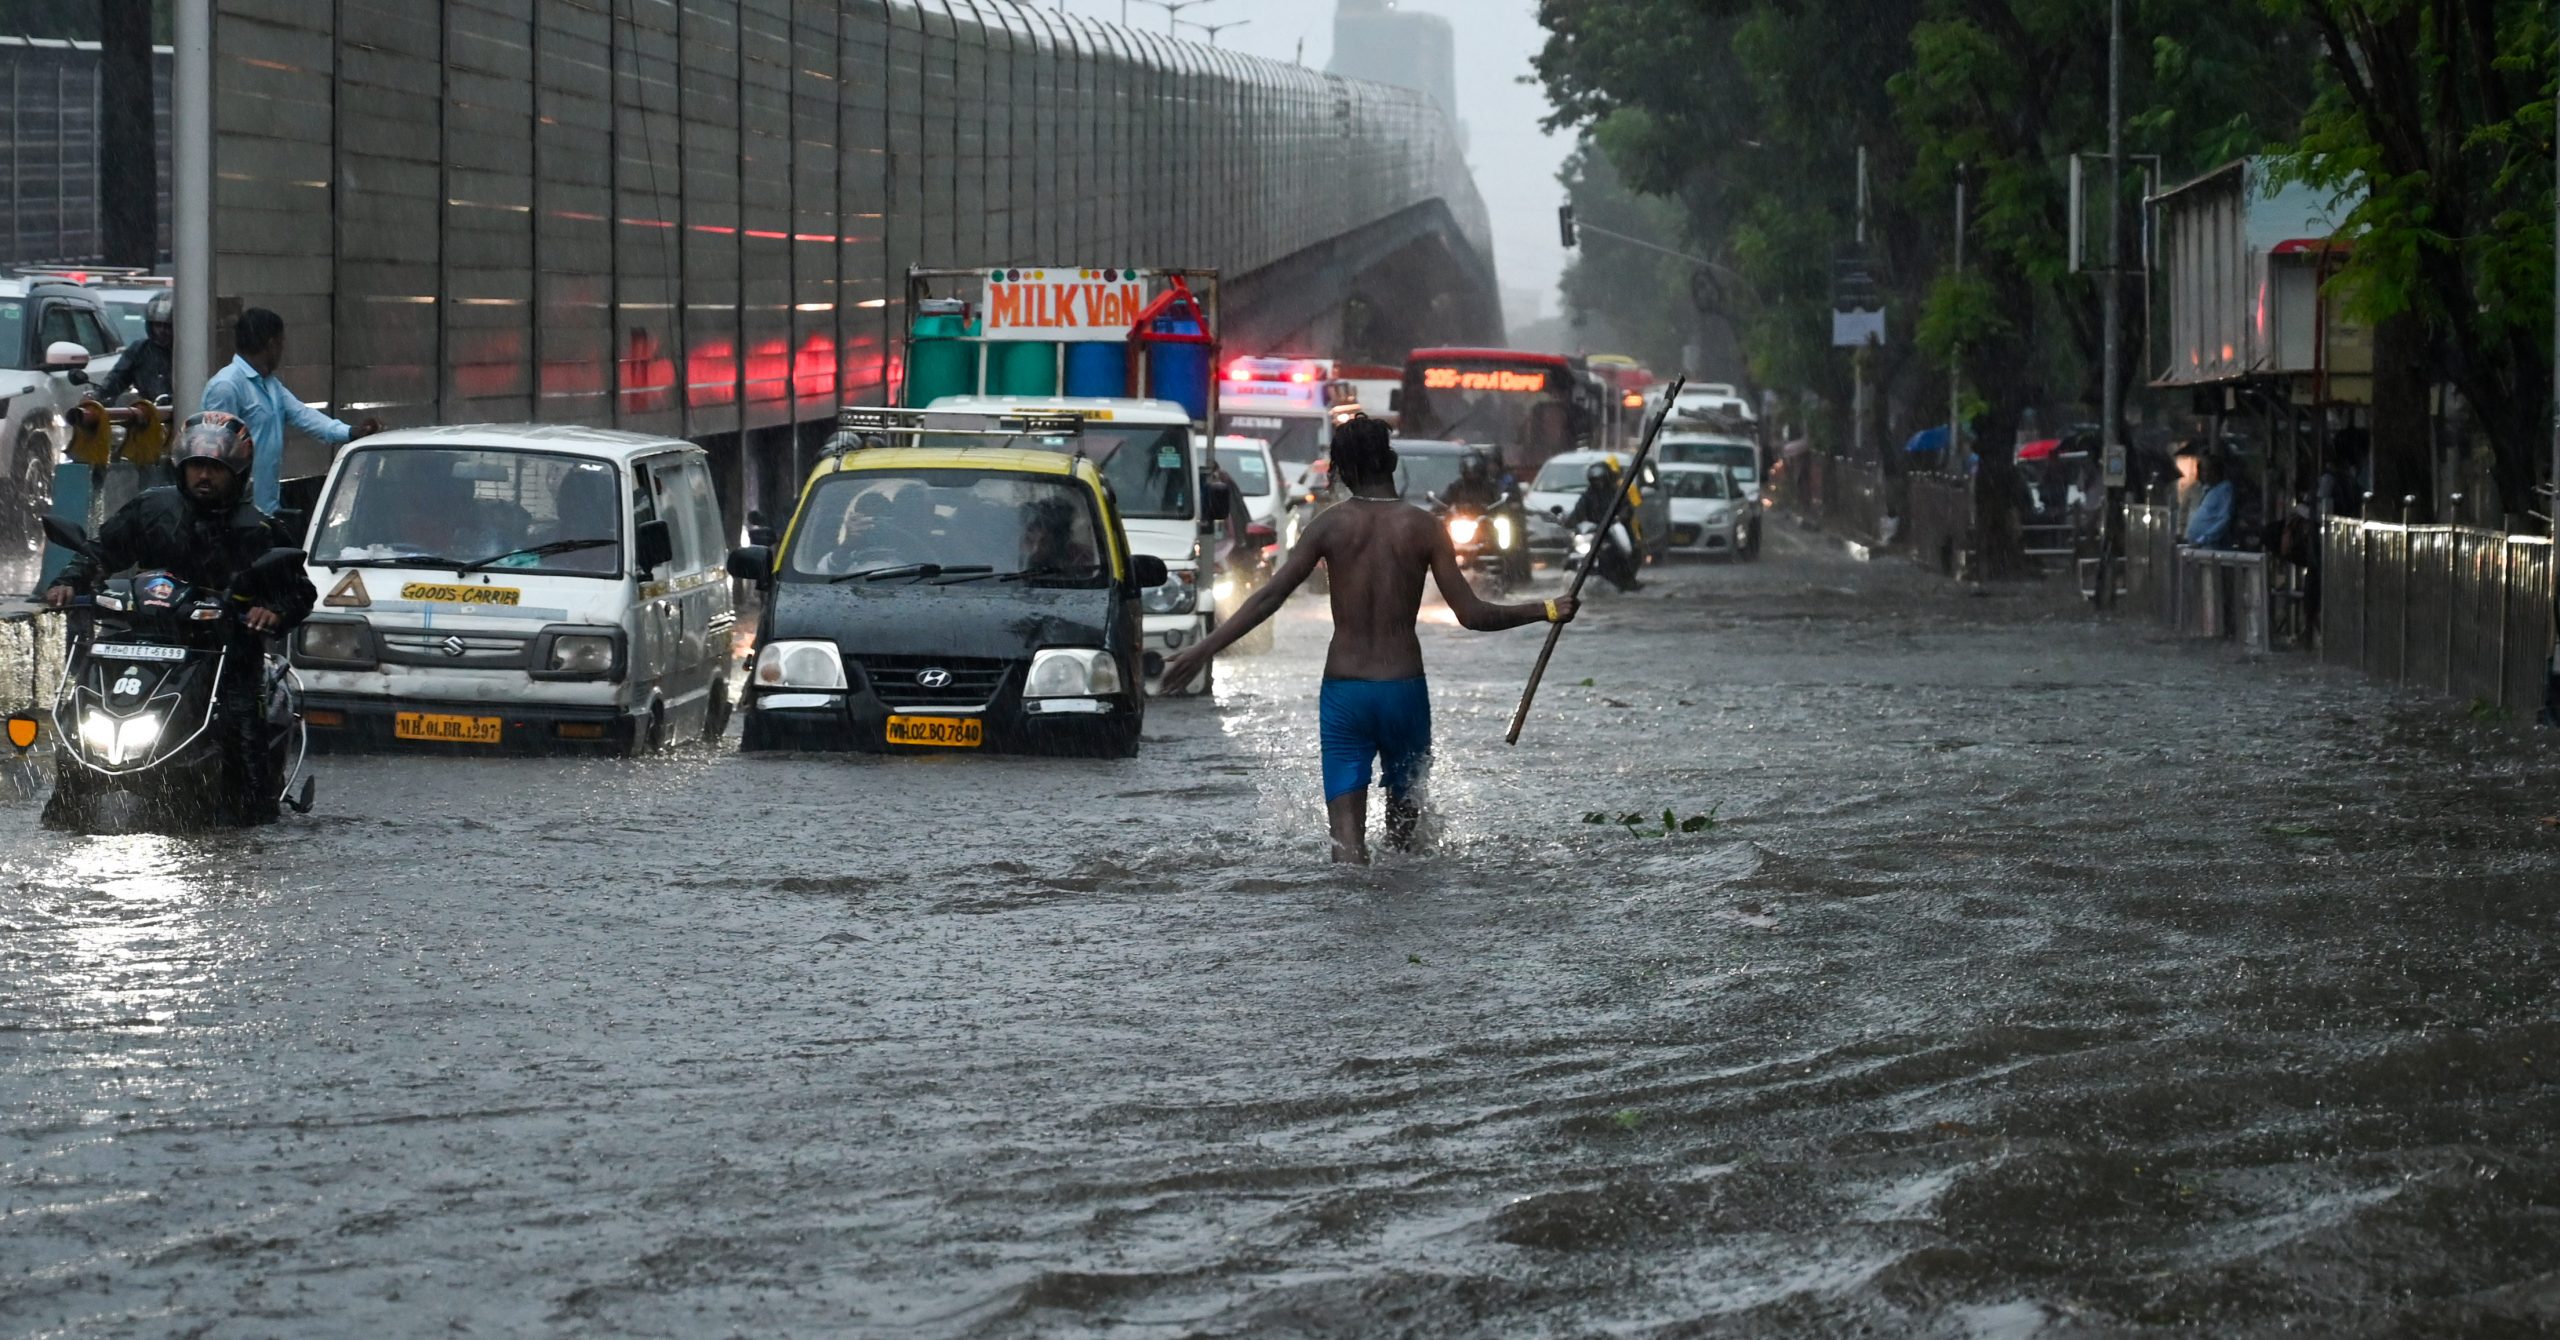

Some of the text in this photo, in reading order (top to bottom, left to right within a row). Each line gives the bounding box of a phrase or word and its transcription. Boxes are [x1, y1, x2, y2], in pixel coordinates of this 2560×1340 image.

[989, 284, 1079, 328] MILK
[1230, 415, 1283, 430] JEEVAN
[462, 587, 520, 606] CARRIER
[113, 677, 142, 695] 08
